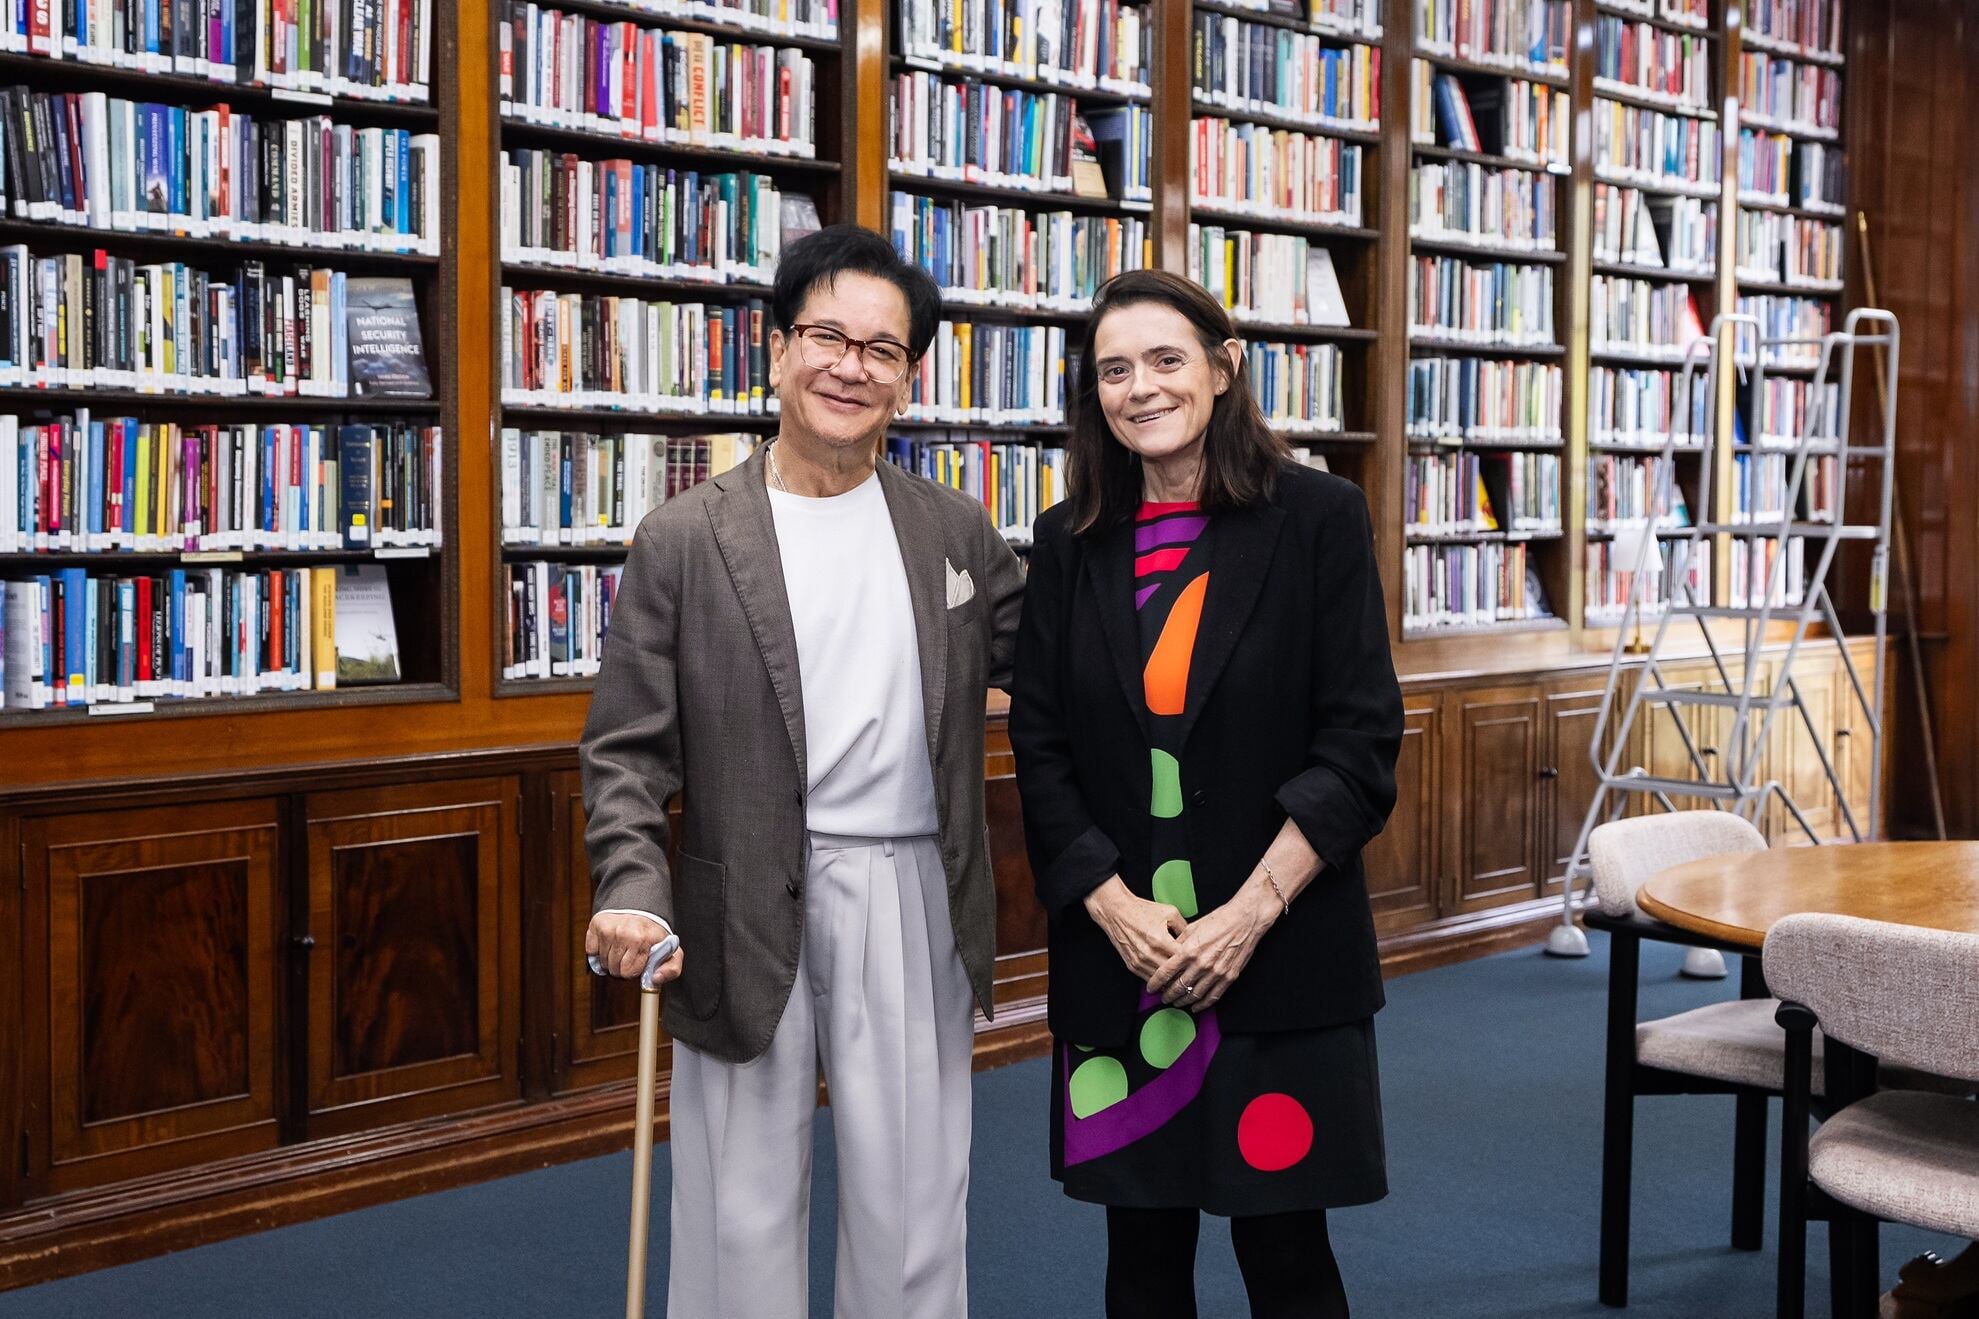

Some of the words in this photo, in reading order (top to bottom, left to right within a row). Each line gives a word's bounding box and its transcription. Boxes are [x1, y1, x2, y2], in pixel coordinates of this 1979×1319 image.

[353, 31, 364, 57] WAR
[375, 24, 383, 55] NUCLEAR
[375, 56, 383, 72] AGE
[693, 66, 705, 124] CONFLICT
[385, 134, 394, 157] SUPER
[271, 144, 280, 198] COMMAND
[356, 316, 407, 327] NATIONAL
[285, 319, 294, 366] PEACELAND
[361, 329, 407, 341] SECURITY
[352, 343, 420, 355] INTELLIGENCE
[507, 437, 517, 469] 1913
[62, 460, 71, 493] Everyday
[155, 644, 162, 656] OF
